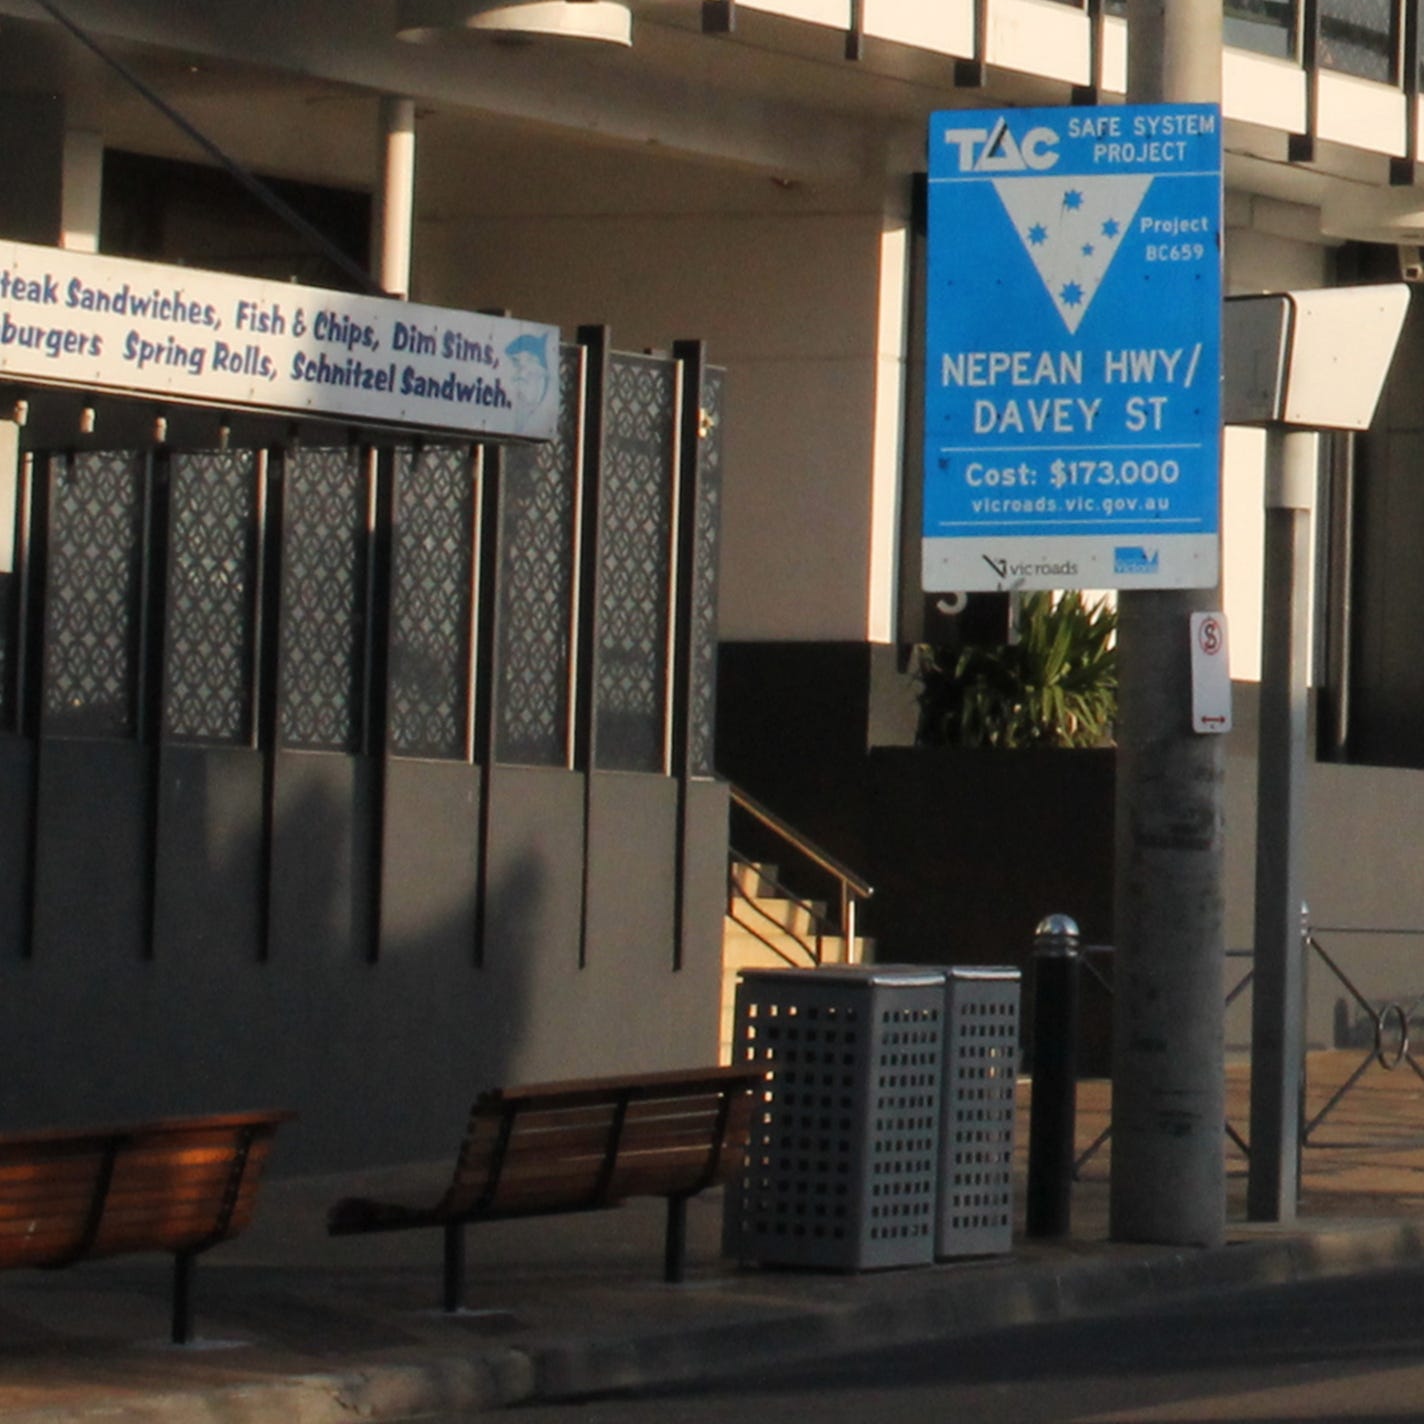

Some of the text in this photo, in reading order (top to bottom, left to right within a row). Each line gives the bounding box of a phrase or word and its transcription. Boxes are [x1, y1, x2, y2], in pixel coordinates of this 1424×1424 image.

[1068, 115, 1215, 138] SAFE SYSTEM
[944, 116, 1060, 172] TAC
[1093, 141, 1187, 164] PROJECT
[1140, 217, 1209, 236] Project
[1145, 244, 1204, 262] BC659
[65, 277, 221, 331] Sandwiches,
[235, 300, 286, 335] Fish
[292, 307, 307, 337] &
[314, 310, 380, 351] Chips,
[392, 321, 436, 357] Dim
[441, 330, 499, 369] Sims,
[0, 313, 512, 409] burgers Spring Rolls, Schnitzel Sandwich.
[941, 342, 1202, 388] NEPEAN HWY/
[974, 396, 1168, 434] DAVEY ST
[965, 461, 1038, 488] Cost:
[971, 497, 1170, 516] vicroads.vic.gov.au
